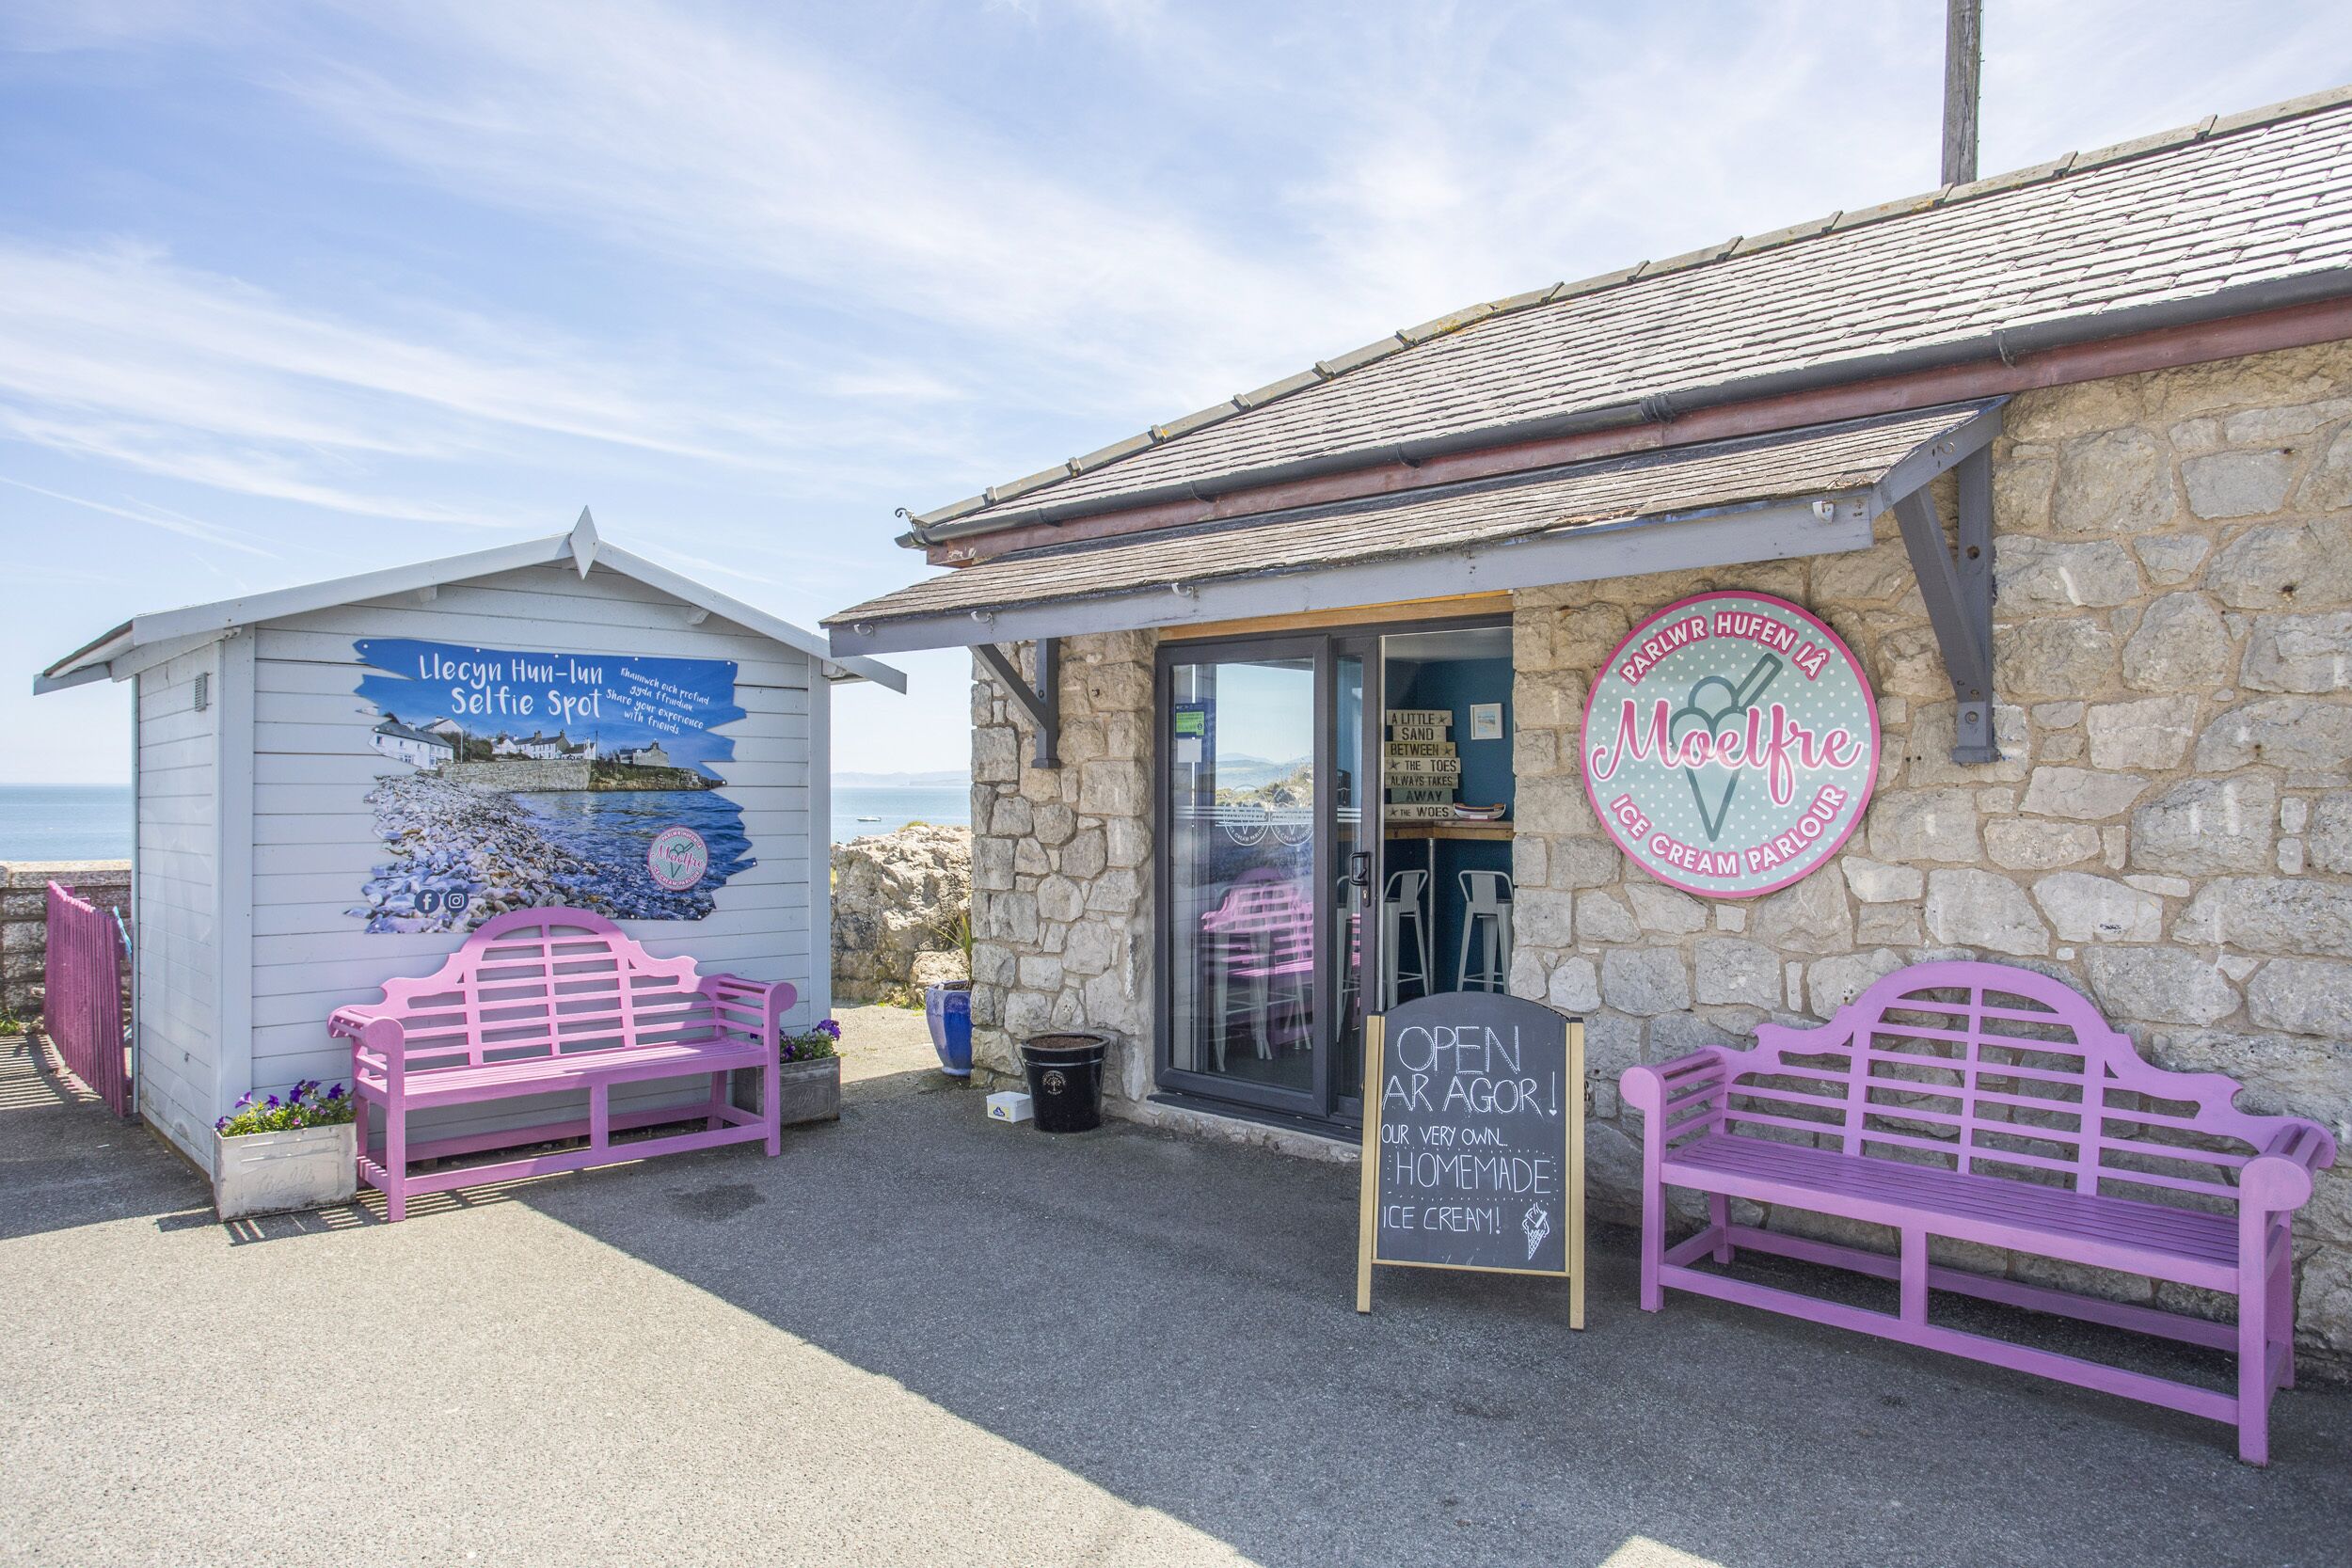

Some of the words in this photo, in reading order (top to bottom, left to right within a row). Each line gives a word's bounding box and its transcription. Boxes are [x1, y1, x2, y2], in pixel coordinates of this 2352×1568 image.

[1623, 618, 1706, 682] PARLWR
[1717, 614, 1794, 651] HUFEN
[1796, 644, 1827, 676] IÂ
[420, 653, 501, 689] Llecyn
[512, 658, 602, 685] Hun-lun
[629, 685, 652, 698] gyda
[679, 689, 709, 705] profiad
[451, 686, 533, 715] Selfie
[548, 689, 602, 725] Spot
[606, 689, 632, 705] Share
[634, 700, 657, 713] your
[659, 708, 704, 729] experience
[624, 710, 644, 723] with
[1391, 713, 1398, 724] A
[1402, 713, 1435, 724] LITTLE
[1402, 727, 1434, 741] SAND
[1391, 743, 1439, 756] BETWEEN
[1591, 699, 1863, 805] Moelfre
[1405, 760, 1421, 771] THE
[1430, 759, 1456, 772] TOES
[1391, 775, 1423, 786] ALWAYS
[1428, 775, 1453, 786] TAKES
[1406, 790, 1442, 801] AWAY
[1400, 809, 1411, 817] THE
[1417, 807, 1449, 817] WOES
[1613, 796, 1647, 837] ICE
[1652, 834, 1738, 875] CREAM
[1748, 787, 1845, 871] PARLOUR
[650, 845, 704, 874] Moelfre
[1398, 1026, 1520, 1074] OPEN
[1382, 1074, 1433, 1112] AR
[1381, 1124, 1409, 1145] OUR
[1420, 1126, 1455, 1146] VERY
[1396, 1151, 1550, 1194] HOMEMADE
[1383, 1206, 1415, 1228] ICE
[1423, 1207, 1501, 1234] CREAM!
